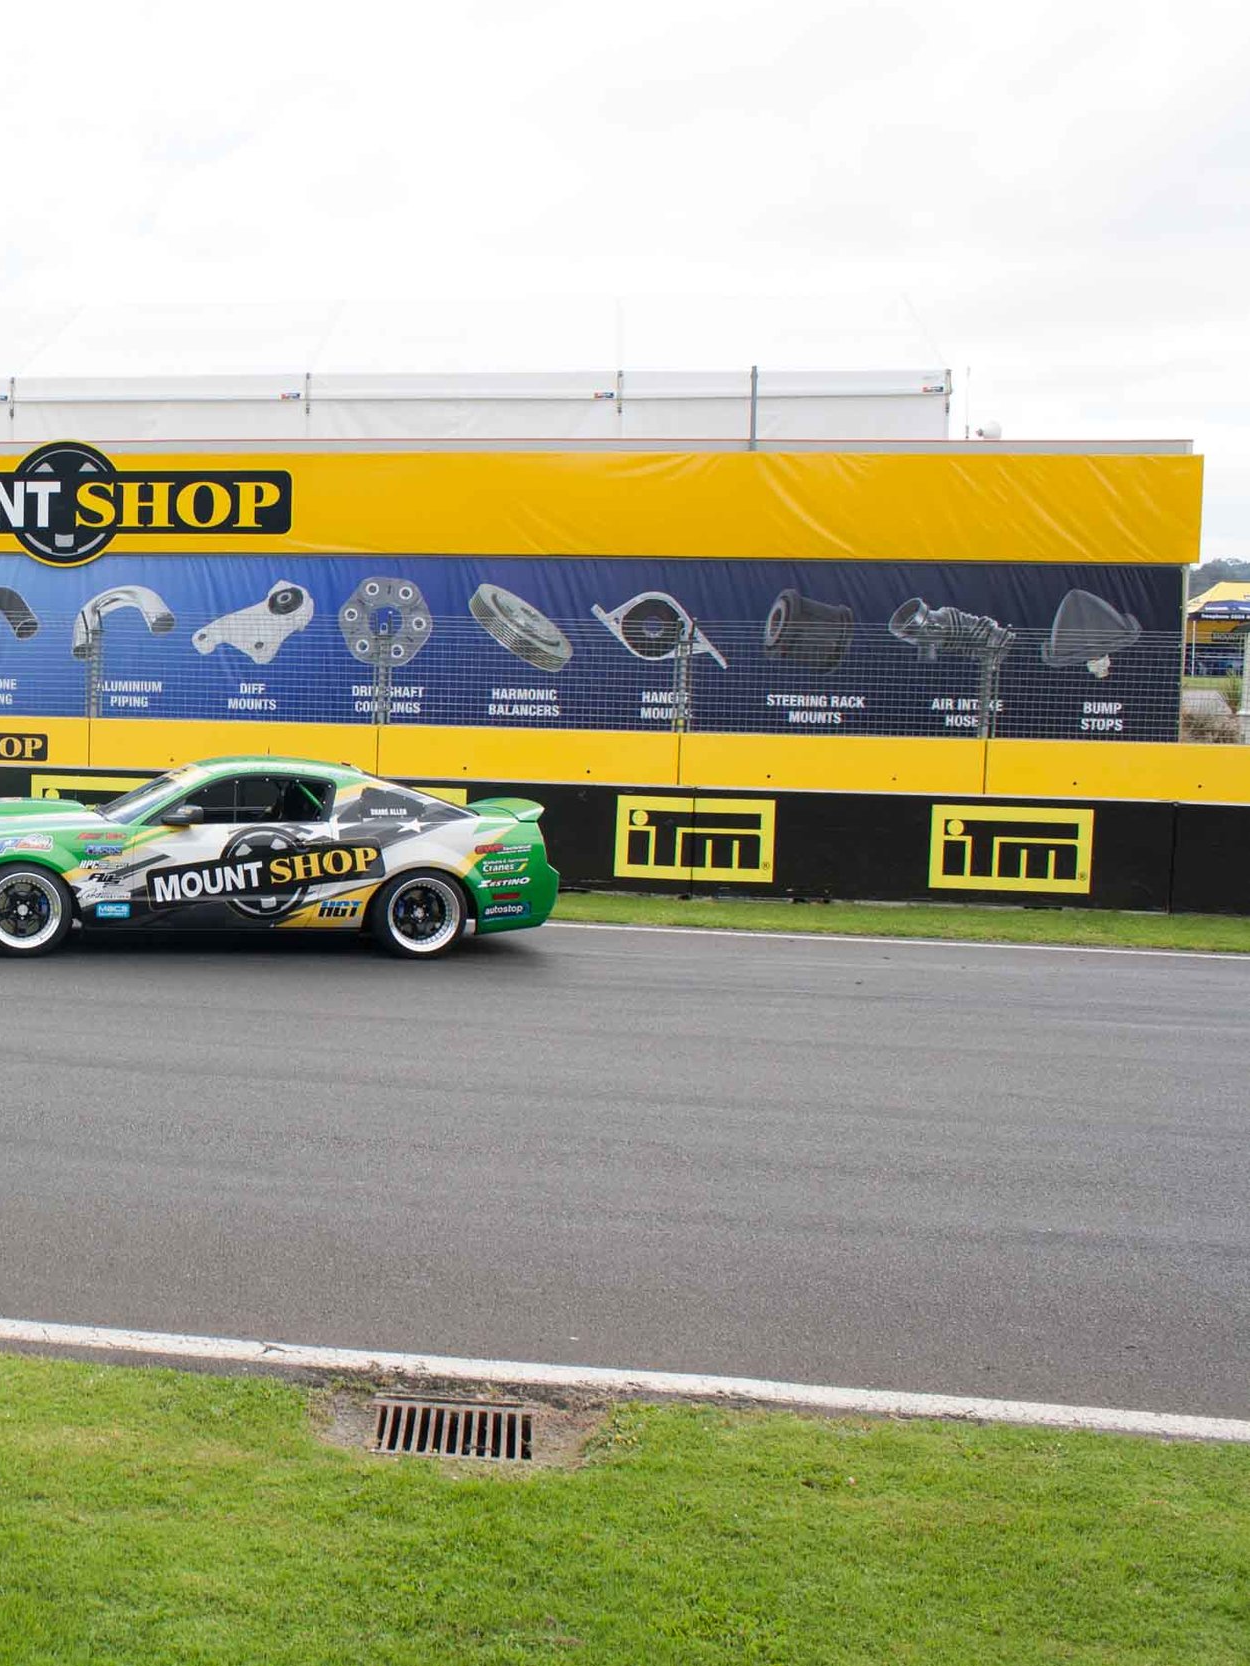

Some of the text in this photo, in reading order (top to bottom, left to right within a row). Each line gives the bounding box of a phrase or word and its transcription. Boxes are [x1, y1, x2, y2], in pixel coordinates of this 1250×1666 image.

[75, 481, 280, 528] SHOP
[239, 683, 266, 694] DIFF
[352, 686, 424, 698] DRIVSHAFT
[492, 688, 558, 701] HARMONIC
[110, 696, 148, 707] PIPING
[228, 699, 277, 710] MOUNTS
[355, 700, 421, 713] COUINGS
[766, 694, 866, 709] STEERING RACK
[931, 698, 1002, 711] AIR INTKE
[488, 704, 560, 717] BALANCERS
[641, 707, 692, 720] MOUNS
[1082, 702, 1122, 715] BUMP
[788, 710, 842, 724] MOUNTS
[945, 714, 979, 727] HOSE
[1080, 718, 1123, 731] STOPS
[153, 847, 378, 902] MOUNT SHOP
[483, 864, 514, 872] Cranes
[485, 905, 523, 915] autostop
